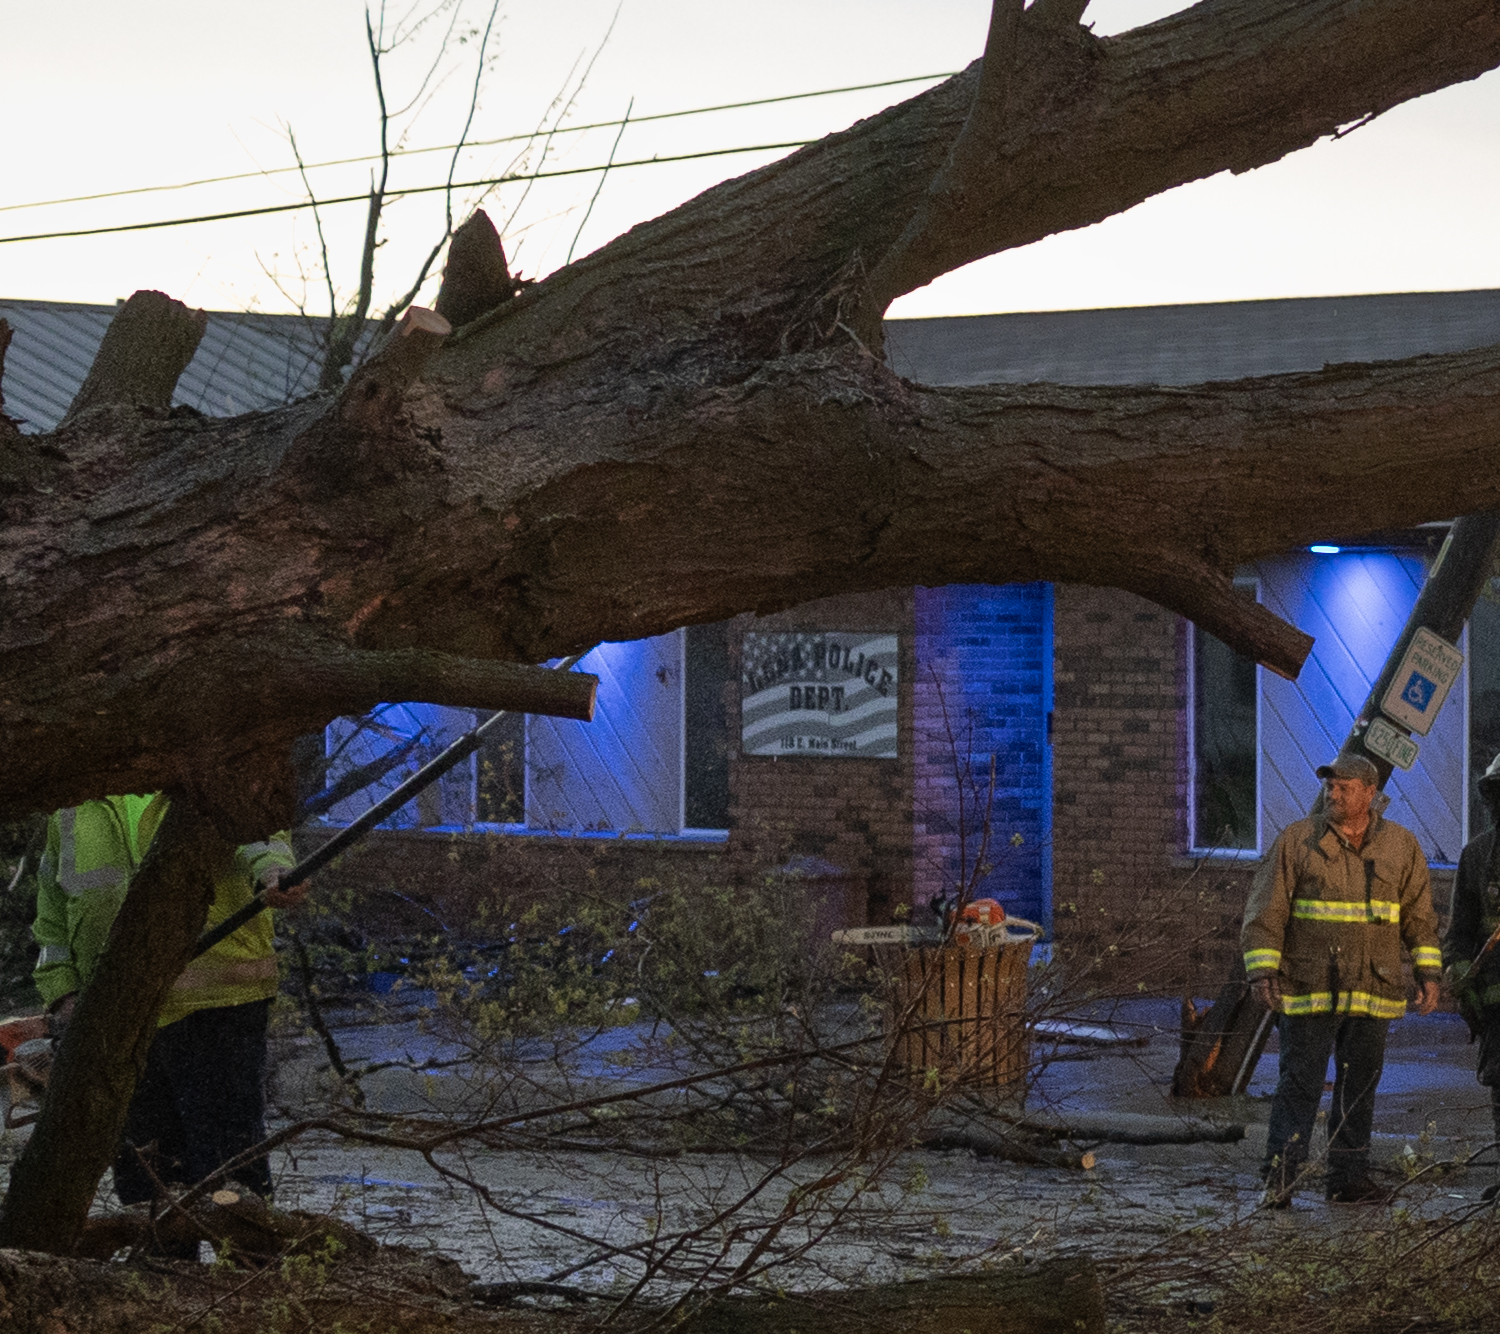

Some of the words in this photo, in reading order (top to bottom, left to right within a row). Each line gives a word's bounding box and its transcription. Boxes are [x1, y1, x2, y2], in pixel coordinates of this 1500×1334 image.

[1410, 652, 1449, 685] PARKING
[1415, 636, 1460, 672] RESERVED
[749, 643, 804, 692] LENA
[814, 642, 893, 697] POLICE
[789, 685, 849, 711] DEPT.
[808, 738, 829, 750] Main
[831, 738, 857, 751] Street
[1391, 740, 1415, 764] FINE
